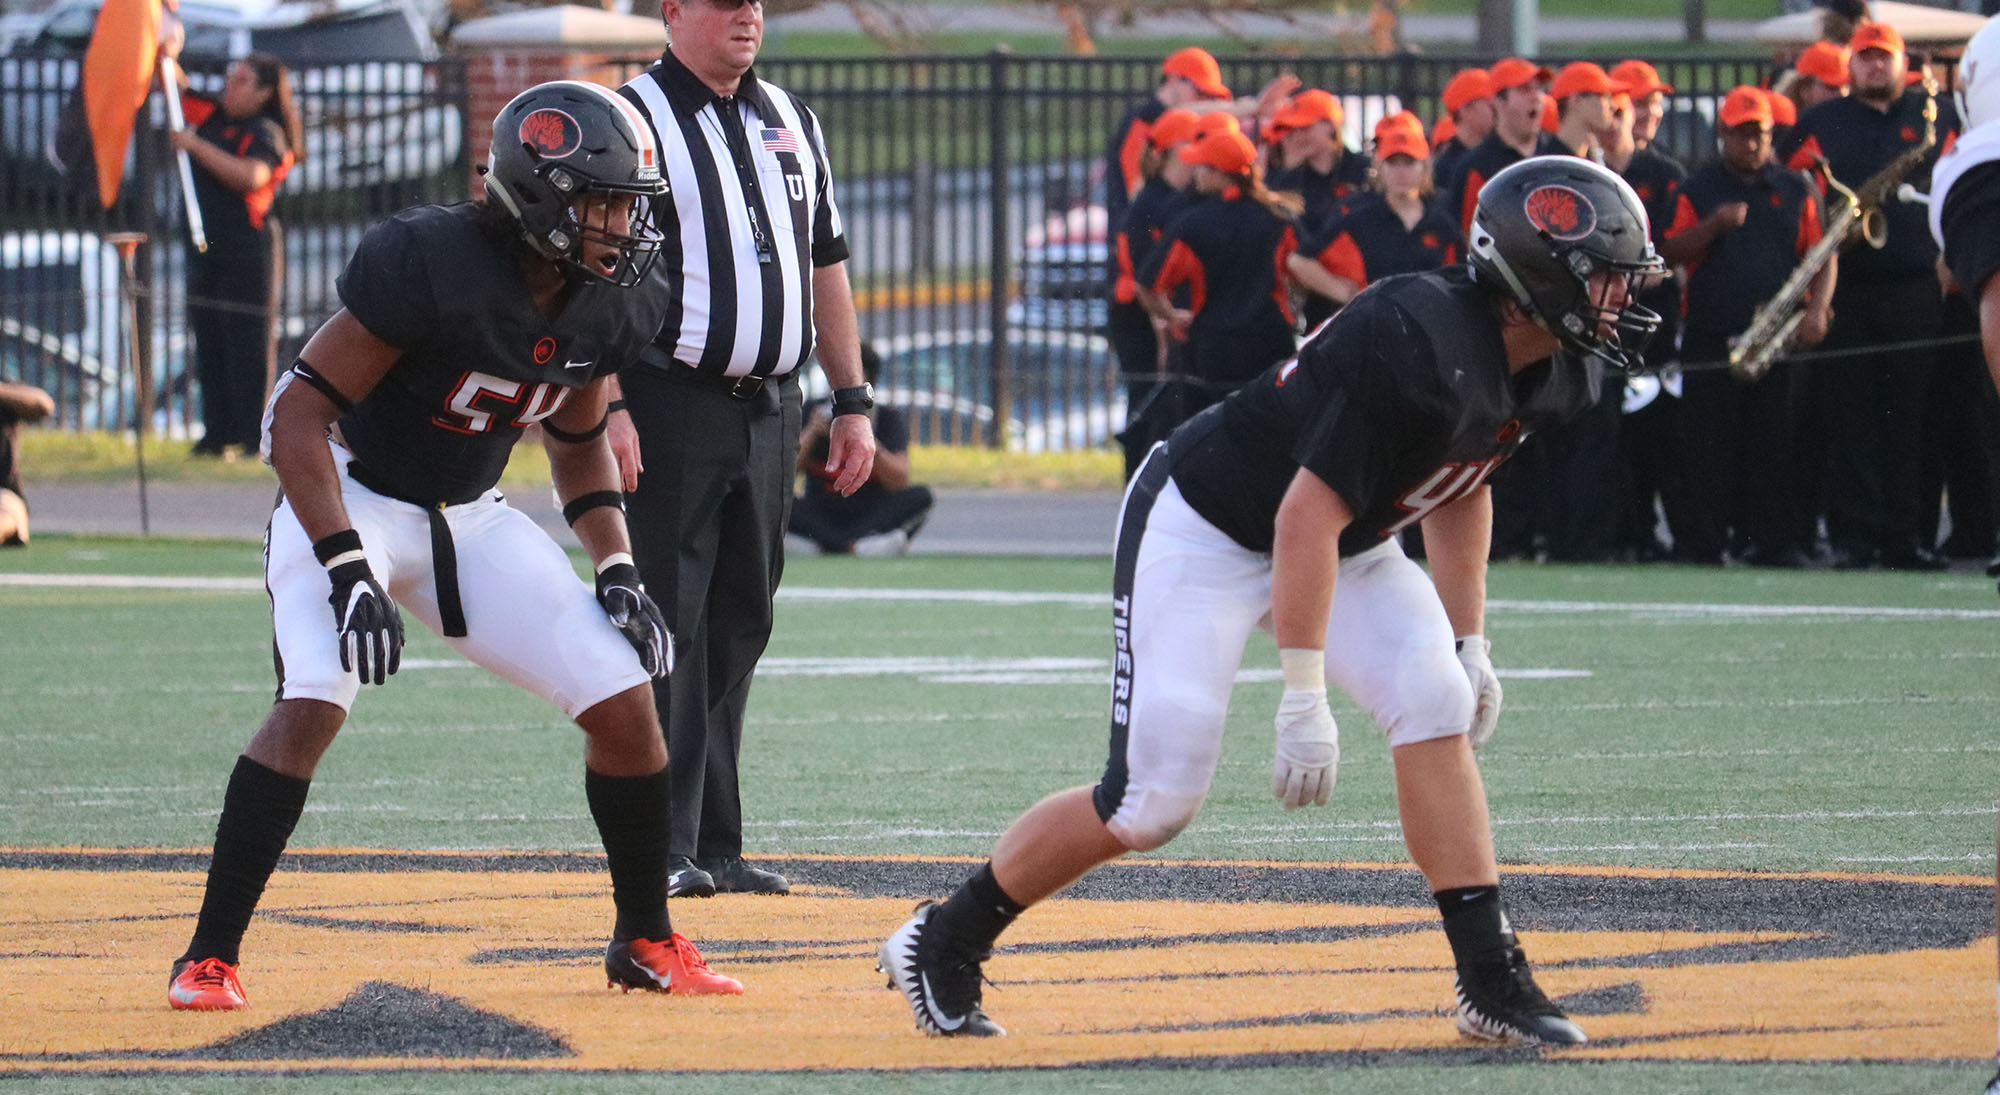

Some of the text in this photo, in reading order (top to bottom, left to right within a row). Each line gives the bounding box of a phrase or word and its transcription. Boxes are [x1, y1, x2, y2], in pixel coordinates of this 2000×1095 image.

[637, 171, 661, 180] Ridde
[785, 174, 804, 201] U
[433, 370, 571, 434] 54
[1378, 455, 1504, 537] 4
[1113, 594, 1132, 727] TIGERS
